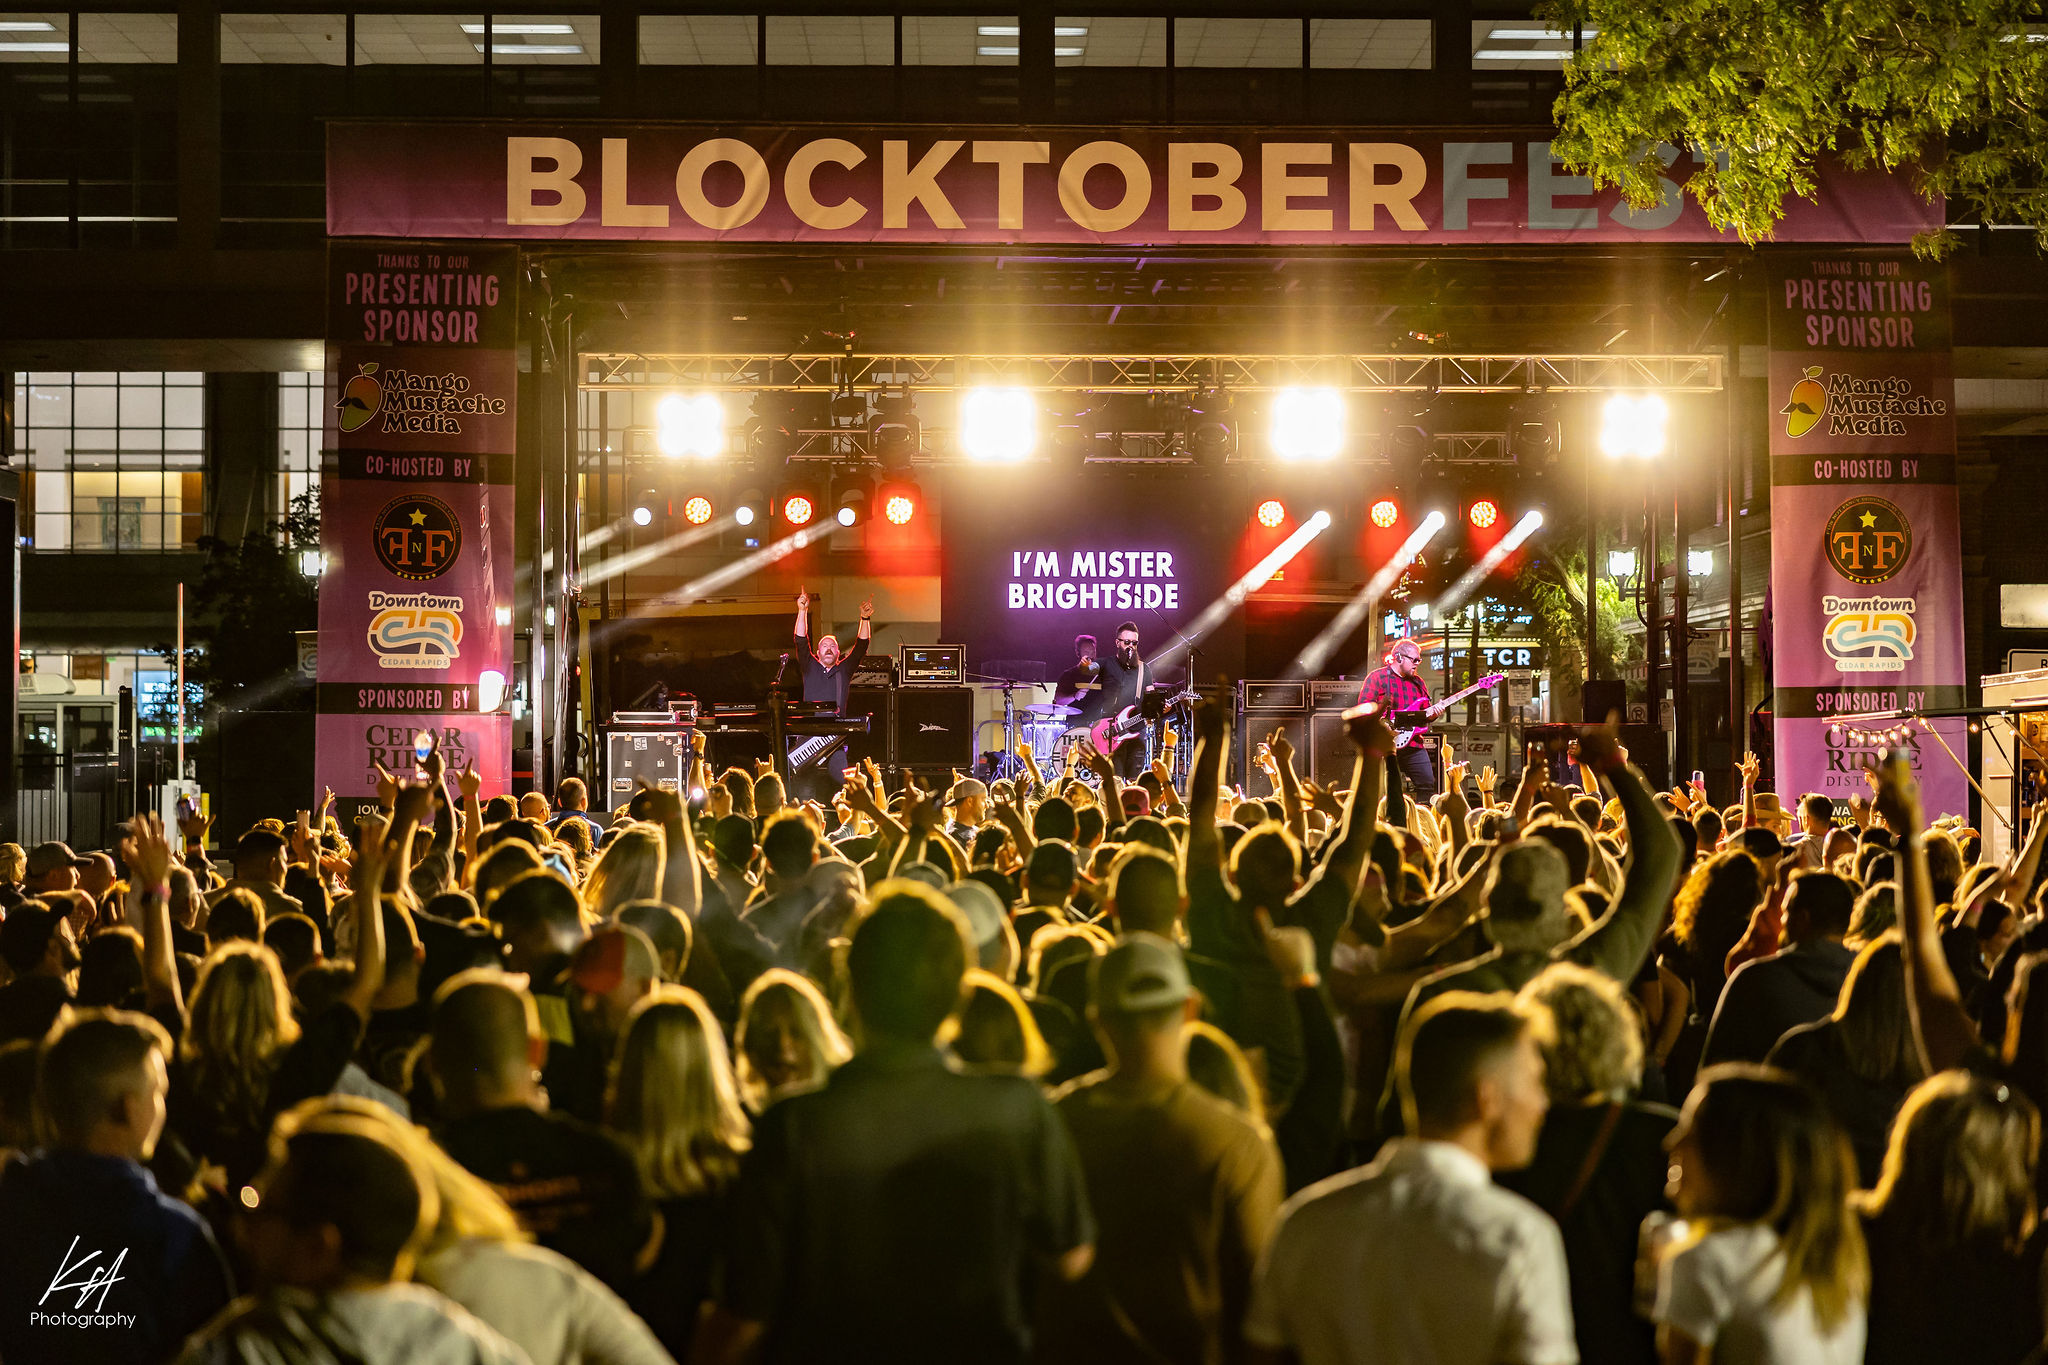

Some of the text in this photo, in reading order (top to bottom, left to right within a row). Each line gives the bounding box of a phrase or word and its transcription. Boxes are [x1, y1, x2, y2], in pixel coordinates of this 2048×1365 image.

[377, 253, 470, 269] THANKS TO OUR
[1811, 261, 1900, 277] THANKS TO OUR
[345, 272, 500, 307] PRESENTING
[1784, 279, 1932, 313] PRESENTING
[363, 309, 479, 343] SPONSOR
[1805, 314, 1915, 348] SPONSOR
[383, 370, 470, 397] Mango
[1828, 373, 1912, 401] Mango
[382, 391, 506, 415] Mustache
[1828, 394, 1947, 417] Mustache
[382, 412, 461, 435] Media
[1828, 415, 1907, 436] Media
[365, 455, 472, 478] CO-HOSTED BY
[1814, 459, 1919, 479] CO-HOSTED BY
[1013, 551, 1175, 578] I'M MISTER
[371, 594, 461, 609] Downtown
[1008, 583, 1179, 609] BRIGHTSIDE
[1825, 598, 1913, 612] Downtown
[381, 658, 448, 667] CEDAR RAPIDS
[1482, 648, 1531, 666] TCR
[1838, 661, 1903, 669] CEDAR RAPIDS
[358, 689, 470, 710] SPONSORED BY
[1815, 692, 1926, 712] SPONSORED BY
[1061, 734, 1085, 746] THE
[366, 747, 466, 771] RIE
[1826, 749, 1923, 773] RIDE
